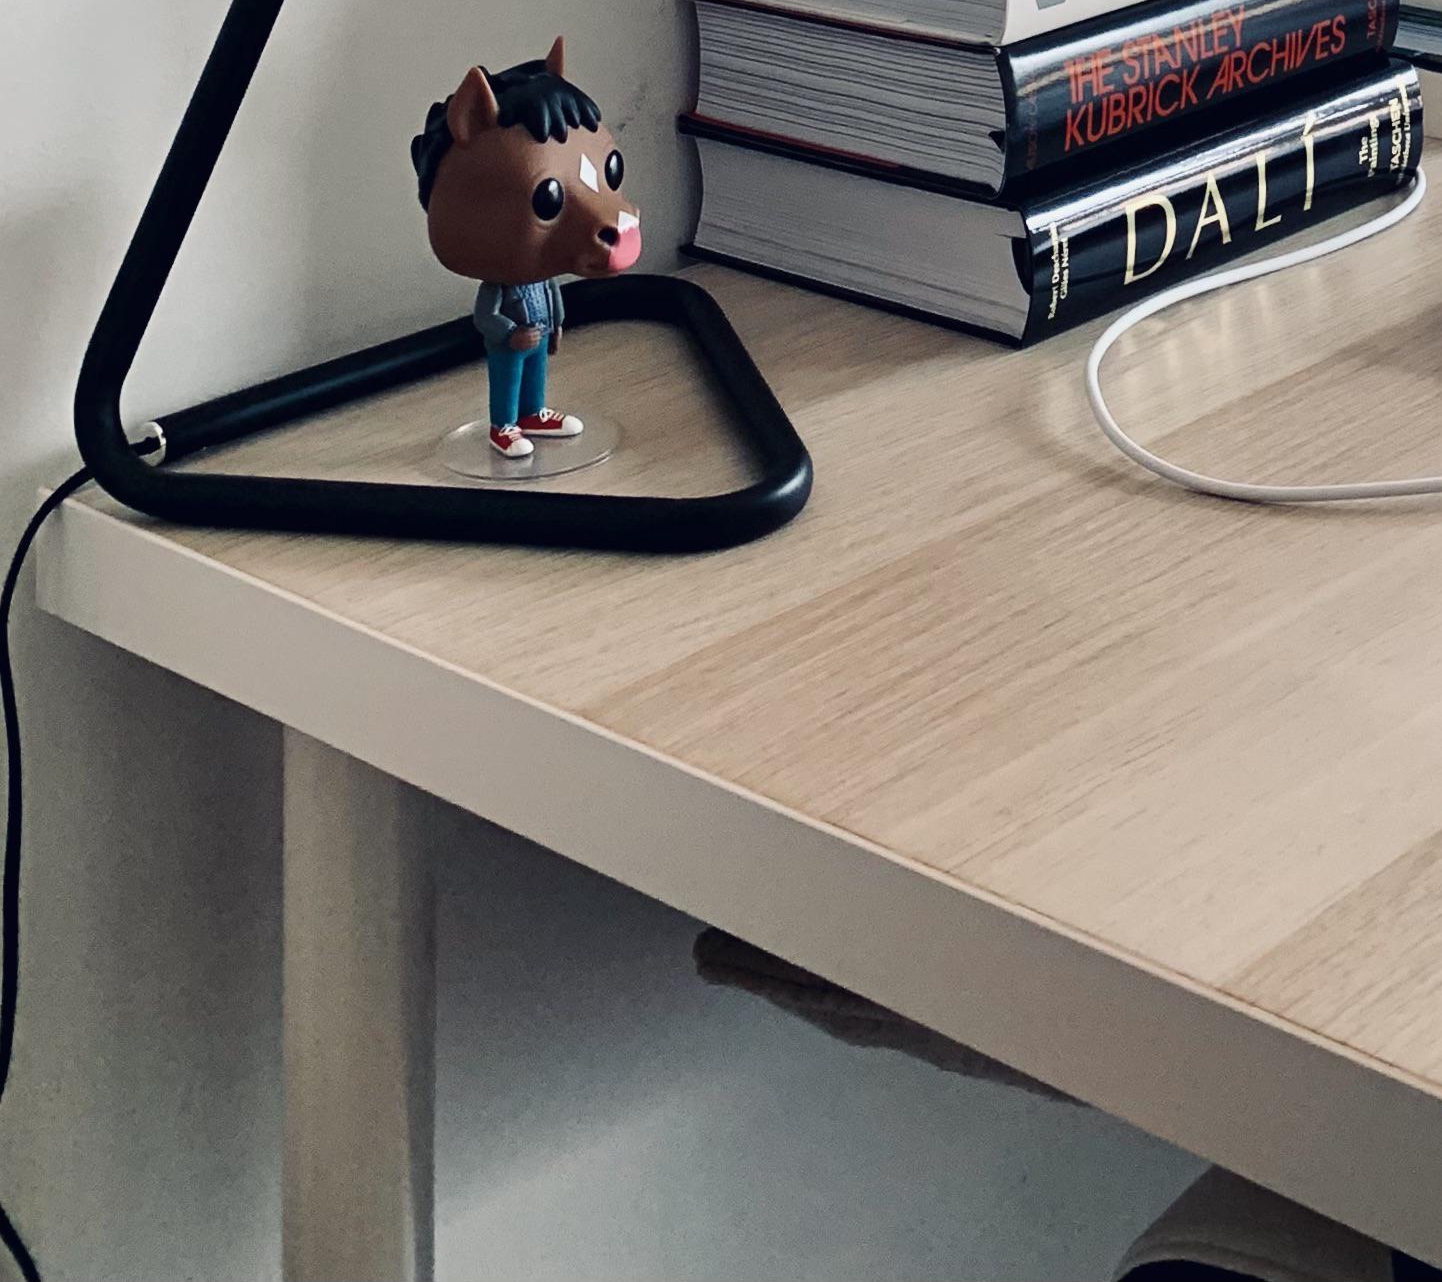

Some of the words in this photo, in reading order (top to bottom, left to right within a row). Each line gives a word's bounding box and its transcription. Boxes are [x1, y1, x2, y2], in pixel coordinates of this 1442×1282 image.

[1062, 48, 1116, 105] THE
[1121, 5, 1247, 82] STANLEY
[1063, 74, 1199, 153] KUBRICK
[1206, 14, 1347, 101] ARCHIVES
[1358, 136, 1369, 166] The
[1389, 96, 1402, 175] TASCHEN
[1123, 111, 1317, 286] DALÍ
